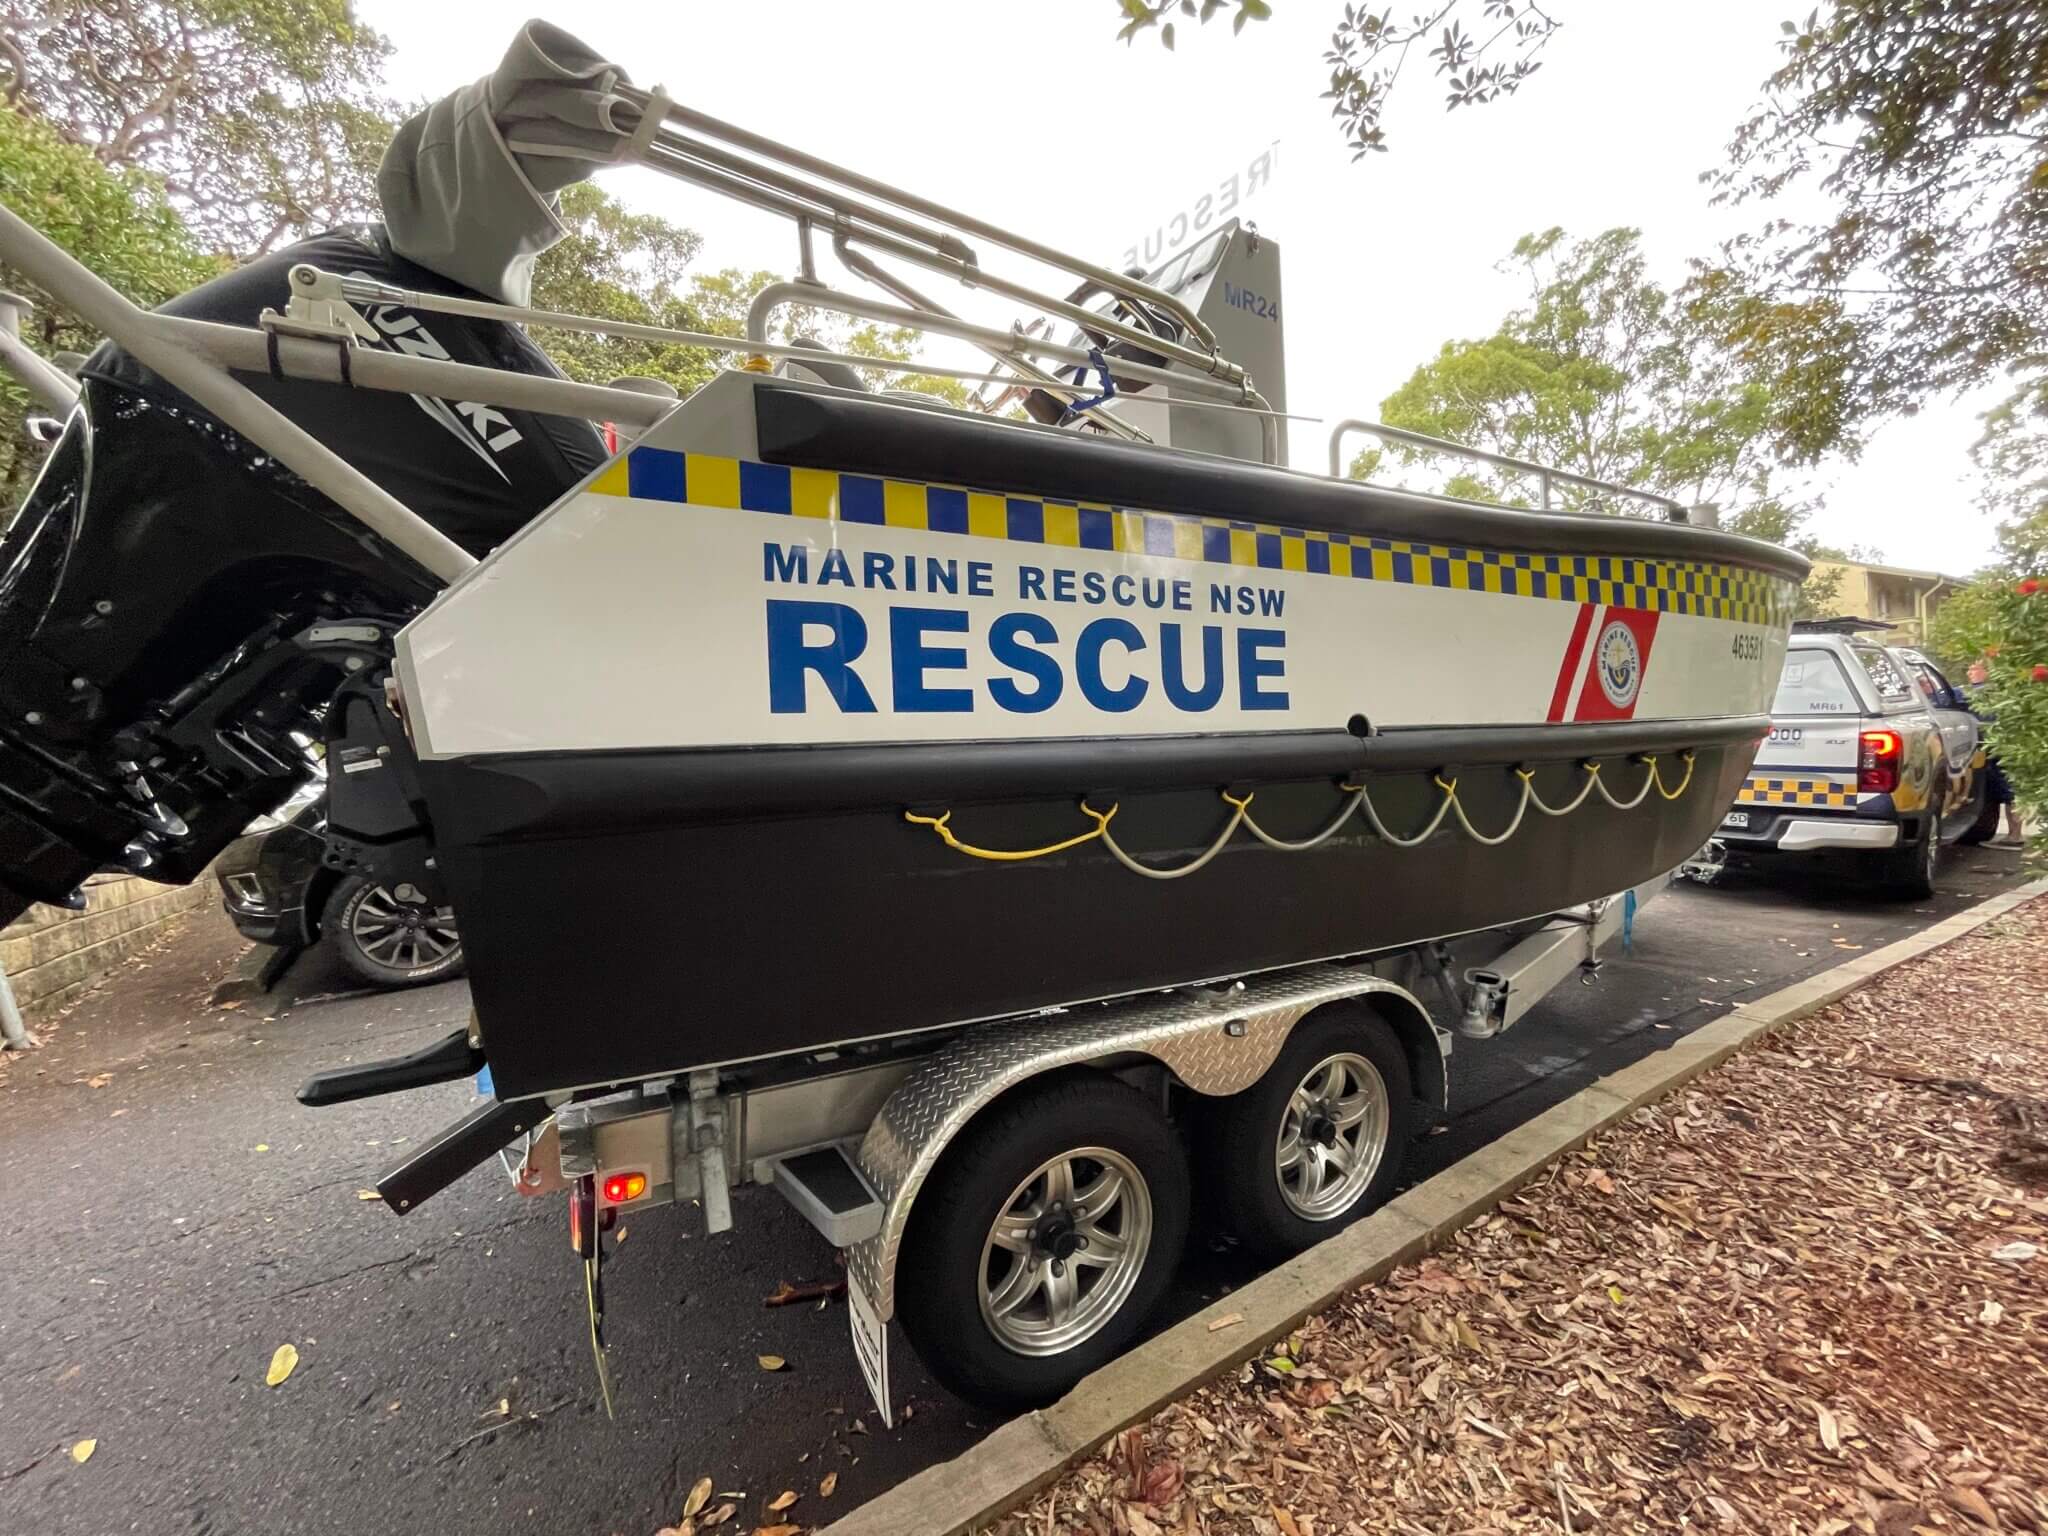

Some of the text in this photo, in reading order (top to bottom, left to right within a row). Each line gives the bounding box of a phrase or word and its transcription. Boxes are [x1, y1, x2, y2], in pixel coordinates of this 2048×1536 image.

[1224, 281, 1279, 323] MR24
[347, 270, 523, 453] UZKI
[763, 542, 1286, 618] MARINE RESCUE NSW
[766, 599, 1290, 715] RESCUE
[1809, 702, 1844, 711] MR61
